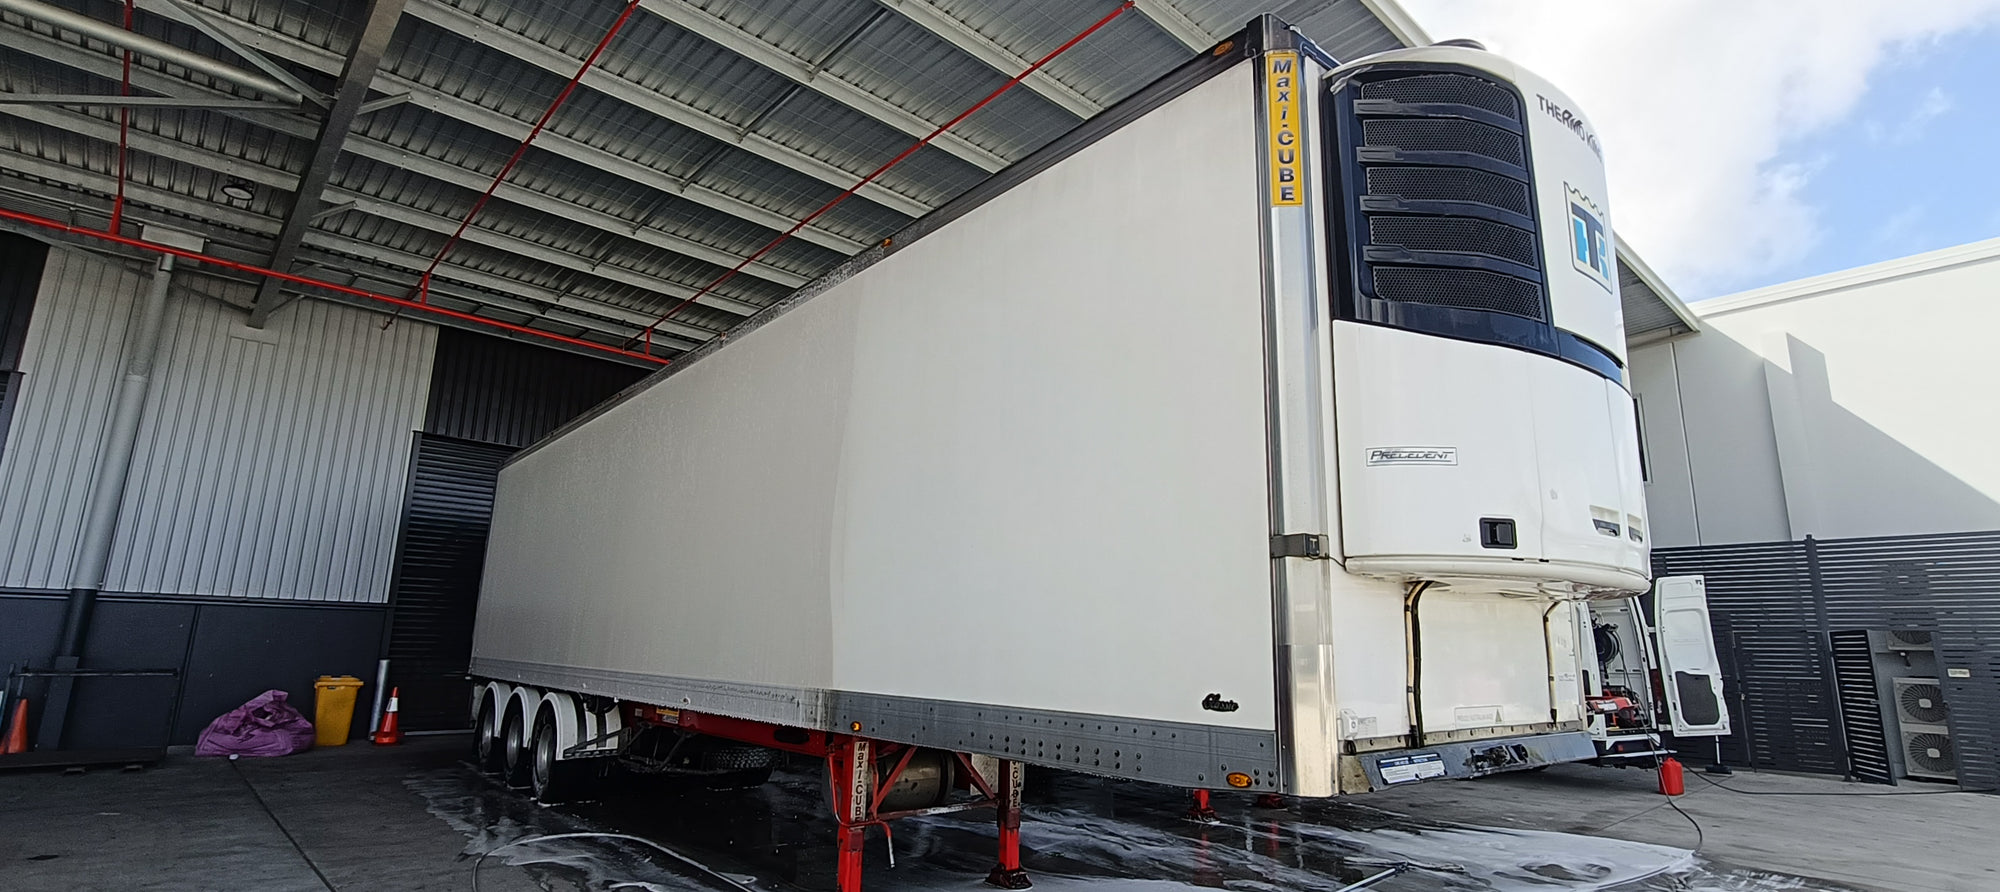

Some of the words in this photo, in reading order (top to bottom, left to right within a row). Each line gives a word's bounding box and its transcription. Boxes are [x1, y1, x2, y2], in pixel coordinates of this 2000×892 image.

[1272, 58, 1295, 201] Maxi-CUBE
[1536, 93, 1586, 142] THERMO
[1586, 131, 1603, 163] KIN
[1370, 450, 1455, 461] PRECEDENT
